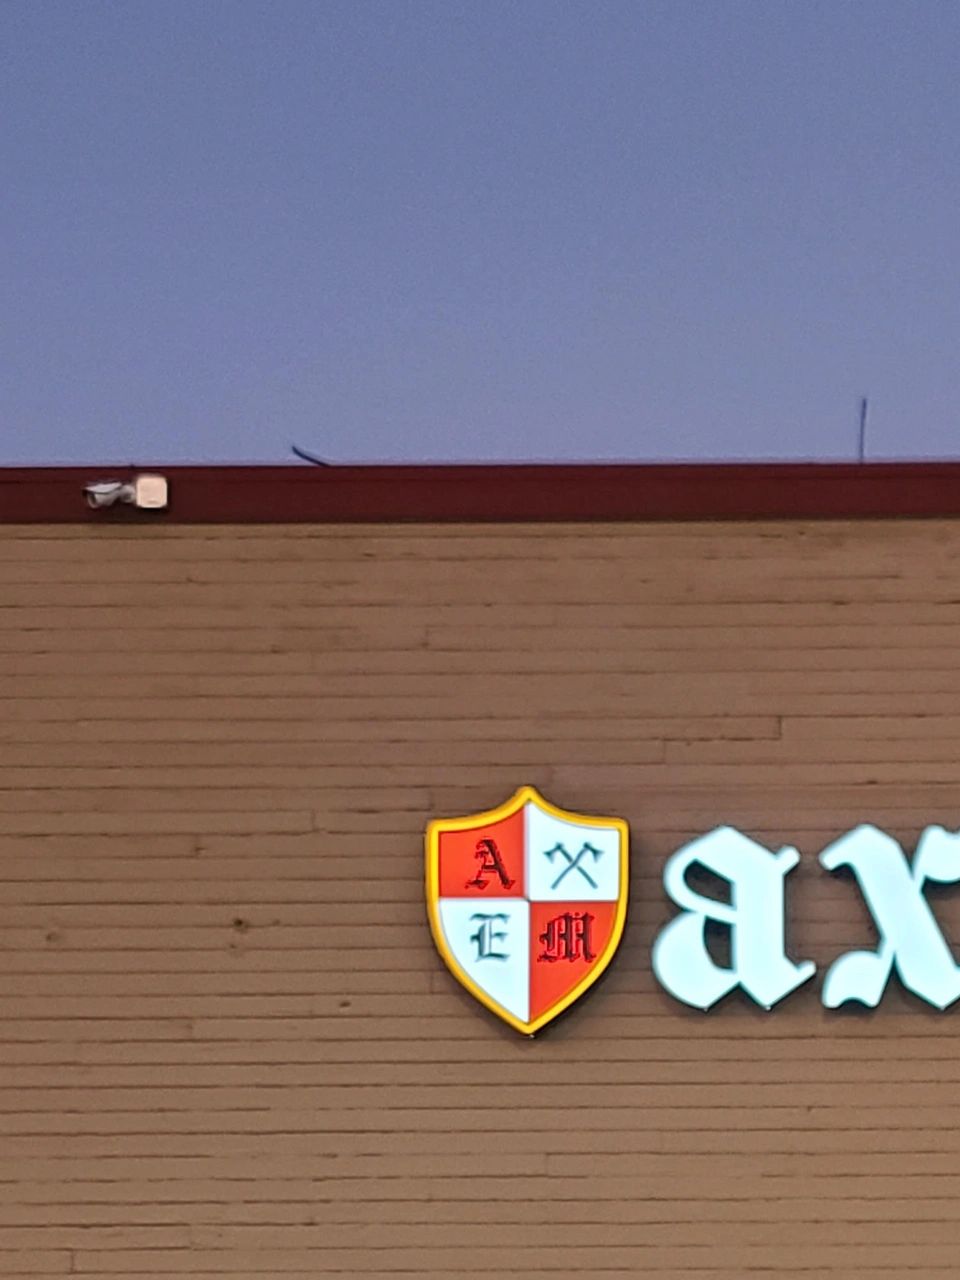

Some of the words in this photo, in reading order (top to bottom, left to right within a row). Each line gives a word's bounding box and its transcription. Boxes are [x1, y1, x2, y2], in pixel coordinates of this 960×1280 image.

[465, 839, 515, 890] A
[469, 912, 511, 963] E
[537, 911, 597, 963] M
